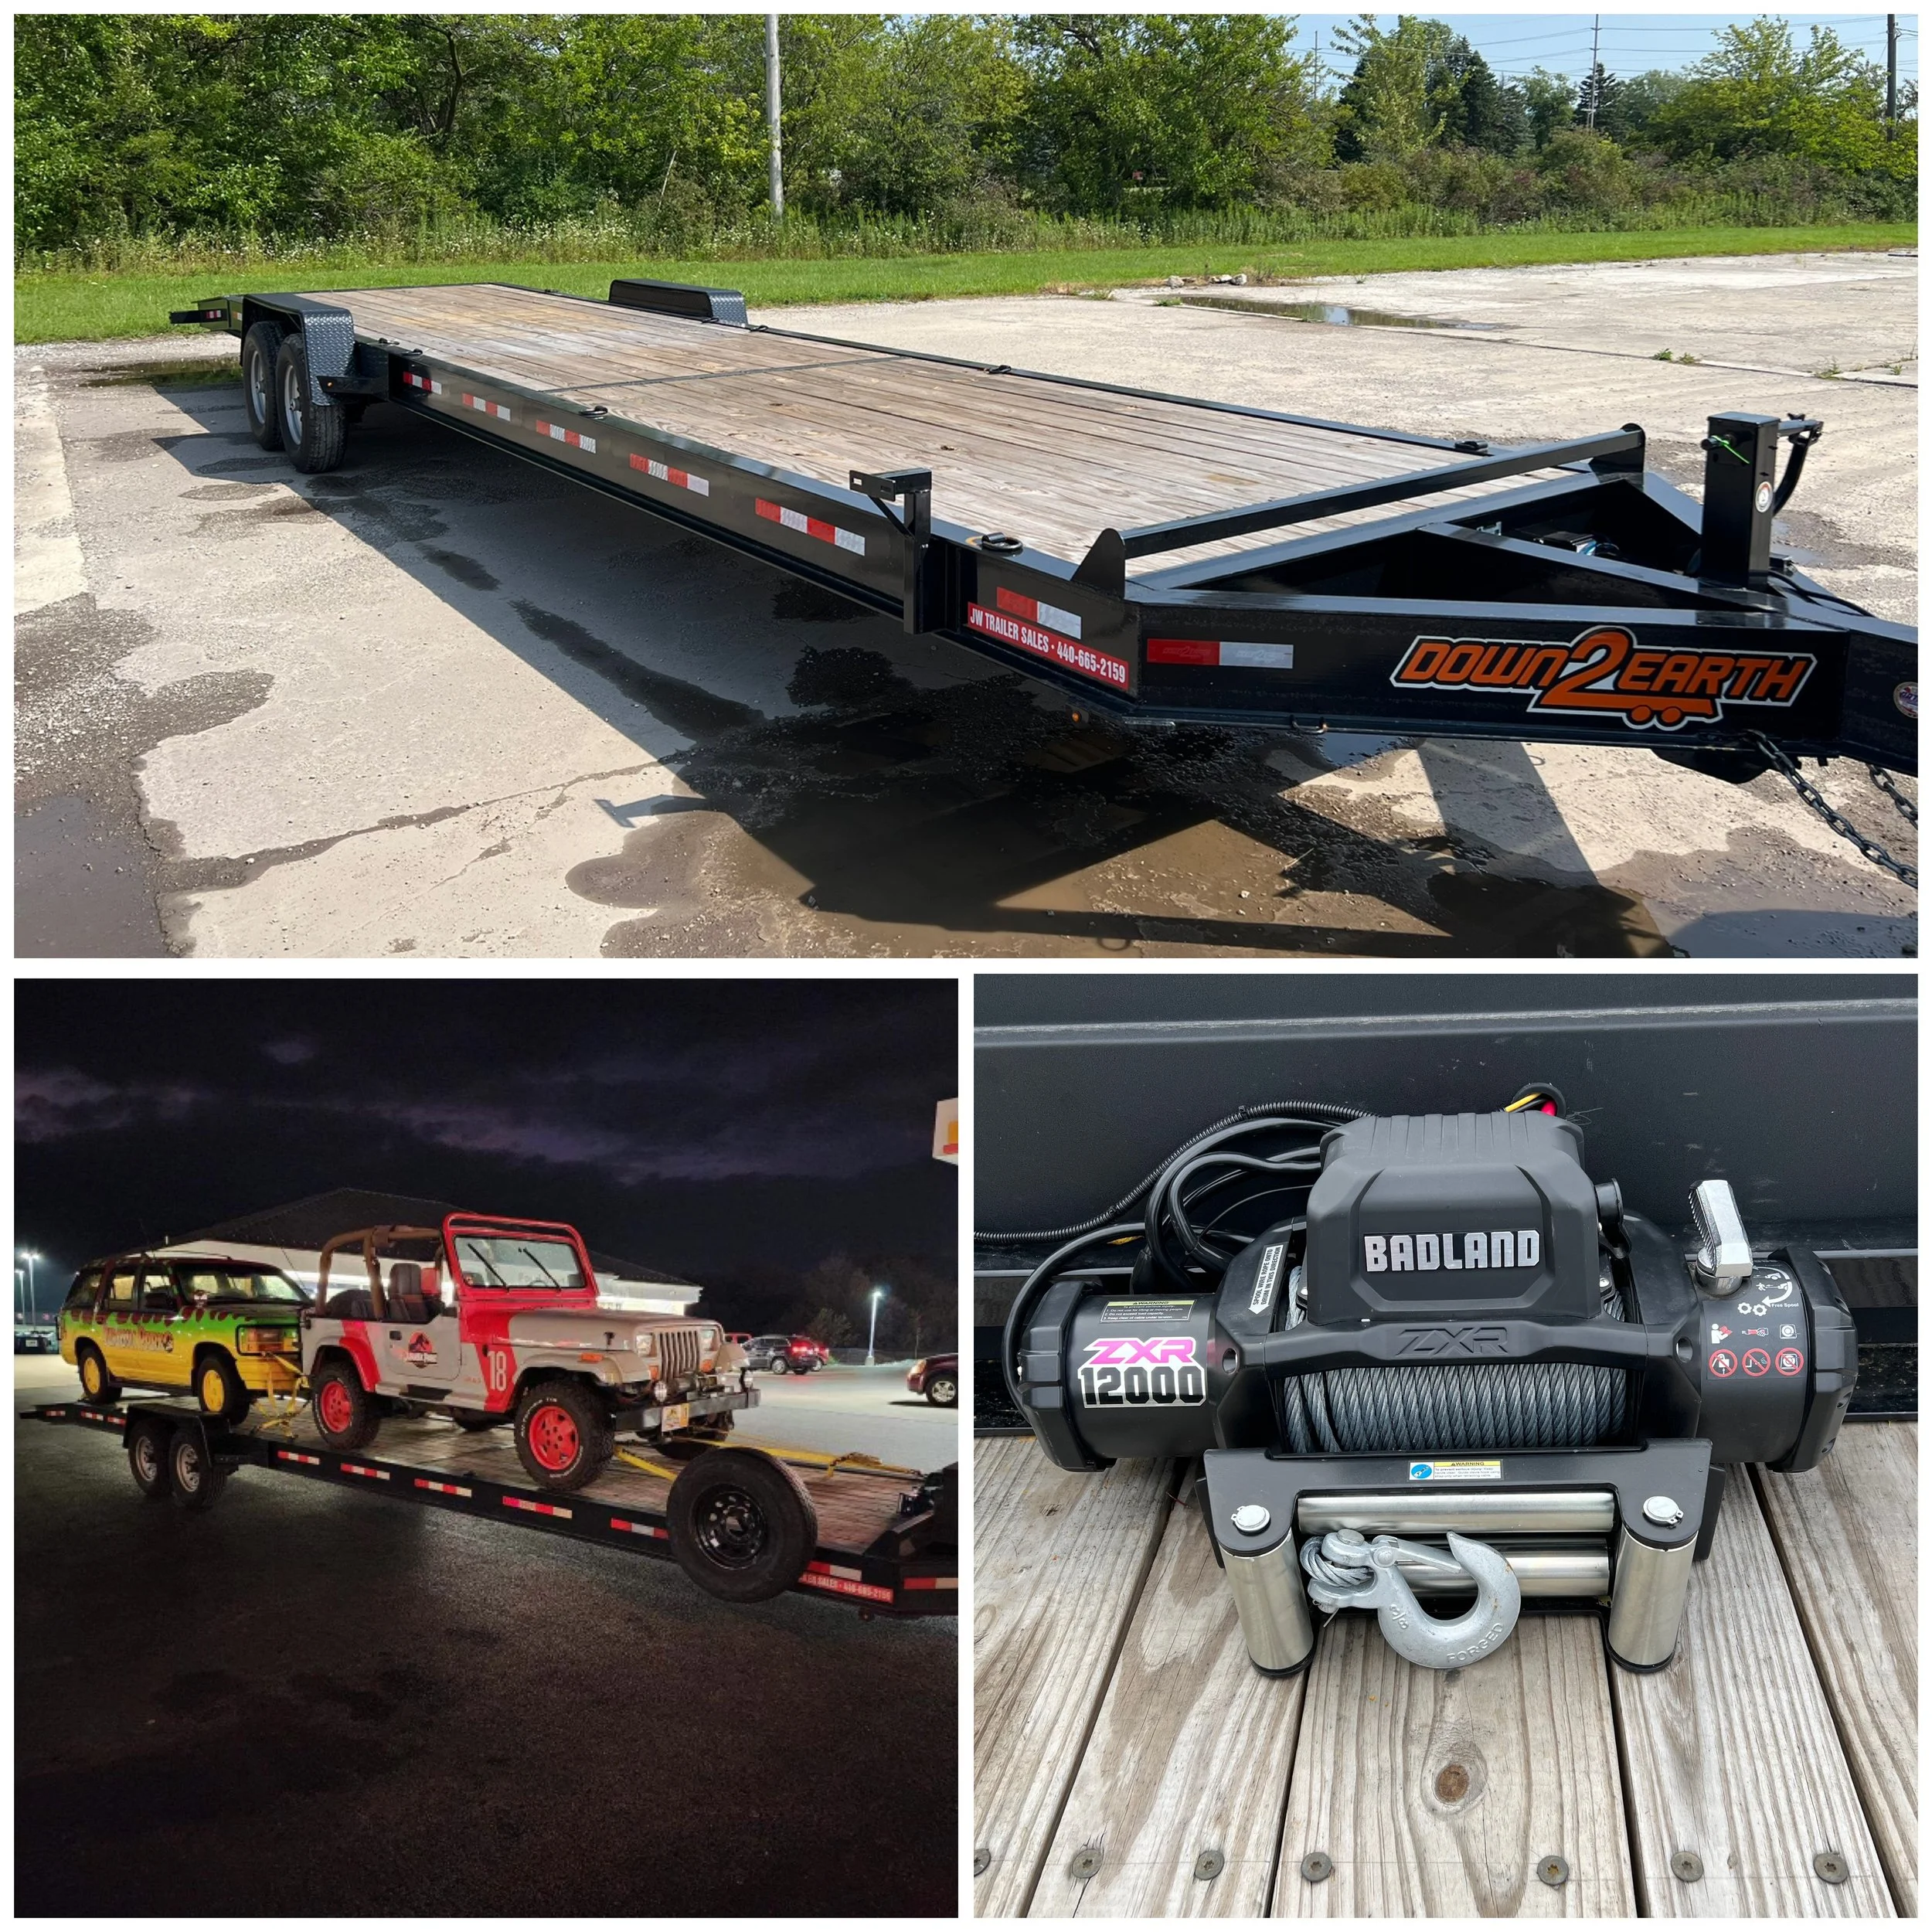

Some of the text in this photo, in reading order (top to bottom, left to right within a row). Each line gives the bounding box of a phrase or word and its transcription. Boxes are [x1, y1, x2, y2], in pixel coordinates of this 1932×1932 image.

[970, 608, 1126, 683] JW TRAILER SALES 440-665-2159
[1261, 1262, 1270, 1275] ROPE
[1364, 1230, 1540, 1272] BADLAND
[1257, 1275, 1266, 1288] WIRE
[1260, 1289, 1270, 1305] DRUM
[1270, 1247, 1281, 1271] DIRECTION
[1253, 1288, 1262, 1305] SPOOL
[1084, 1338, 1195, 1365] ZXR
[1394, 1326, 1509, 1358] ZXR
[487, 1350, 507, 1392] 18
[1079, 1365, 1204, 1405] 12000
[1446, 1622, 1504, 1663] FORGED
